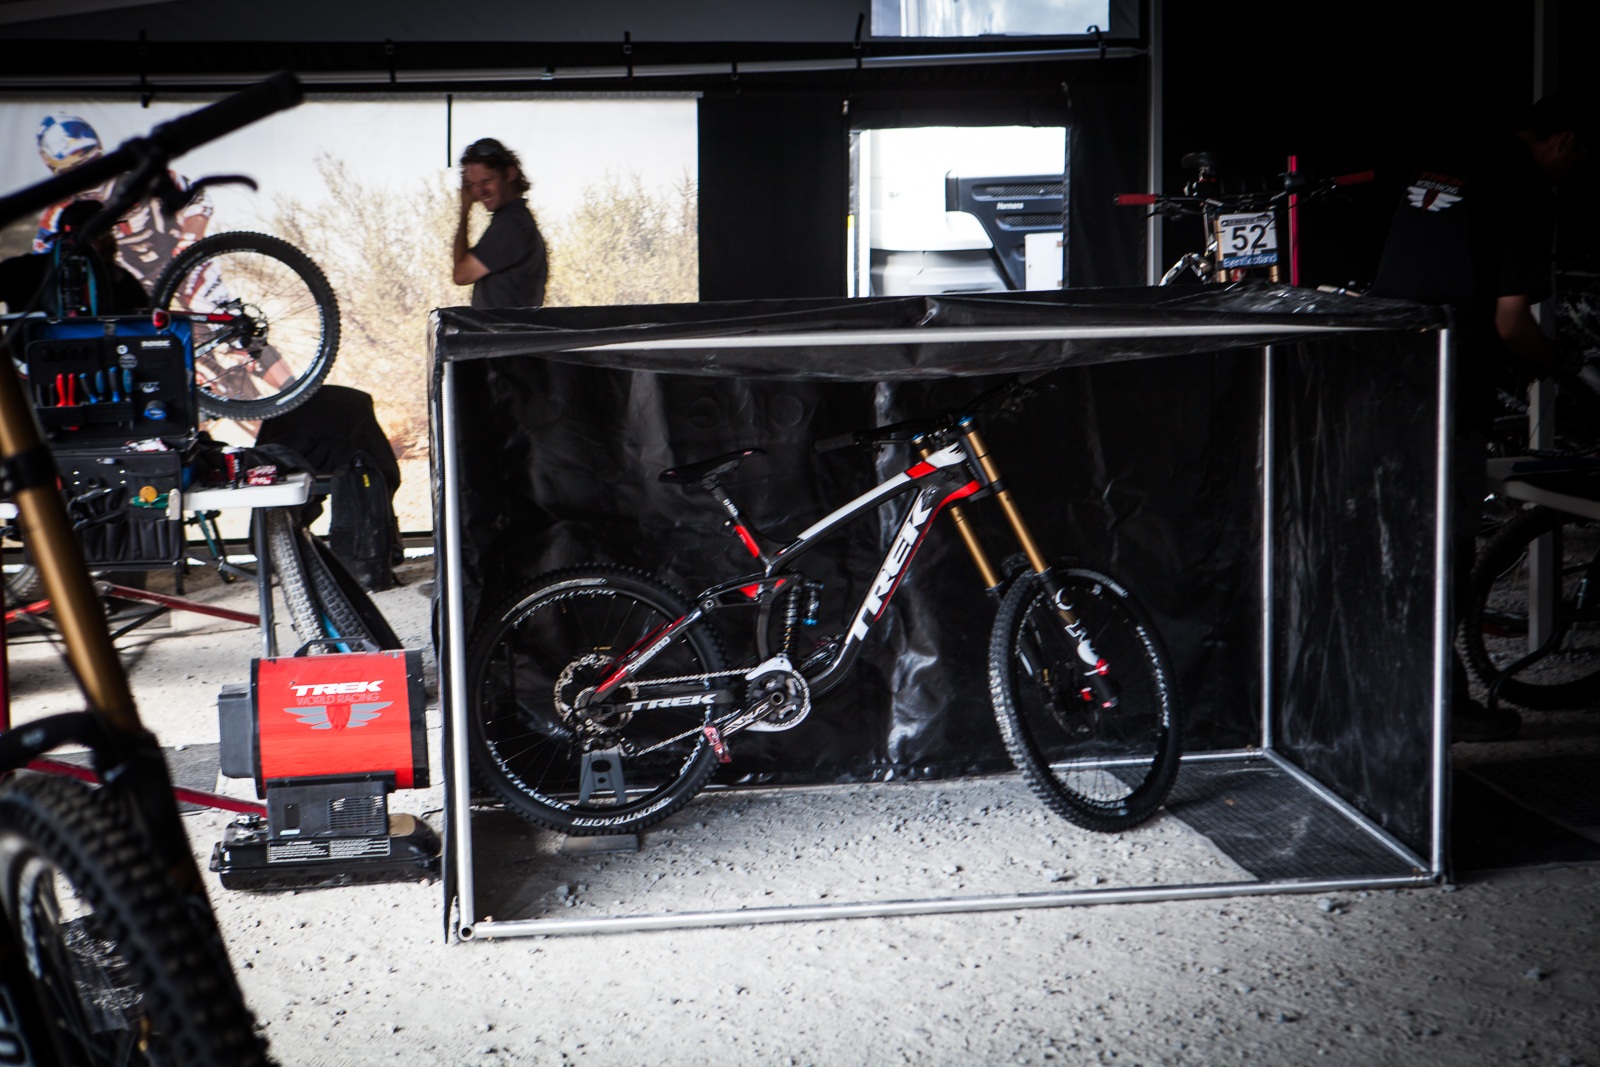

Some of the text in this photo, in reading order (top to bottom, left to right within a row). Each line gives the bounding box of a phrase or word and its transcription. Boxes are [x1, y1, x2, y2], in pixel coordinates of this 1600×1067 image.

[1232, 224, 1267, 250] 52
[844, 495, 932, 645] TREK
[290, 680, 384, 697] TREK
[296, 692, 380, 706] WORLD RACING
[626, 693, 717, 712] TREK
[571, 800, 664, 827] BONTRAGER
